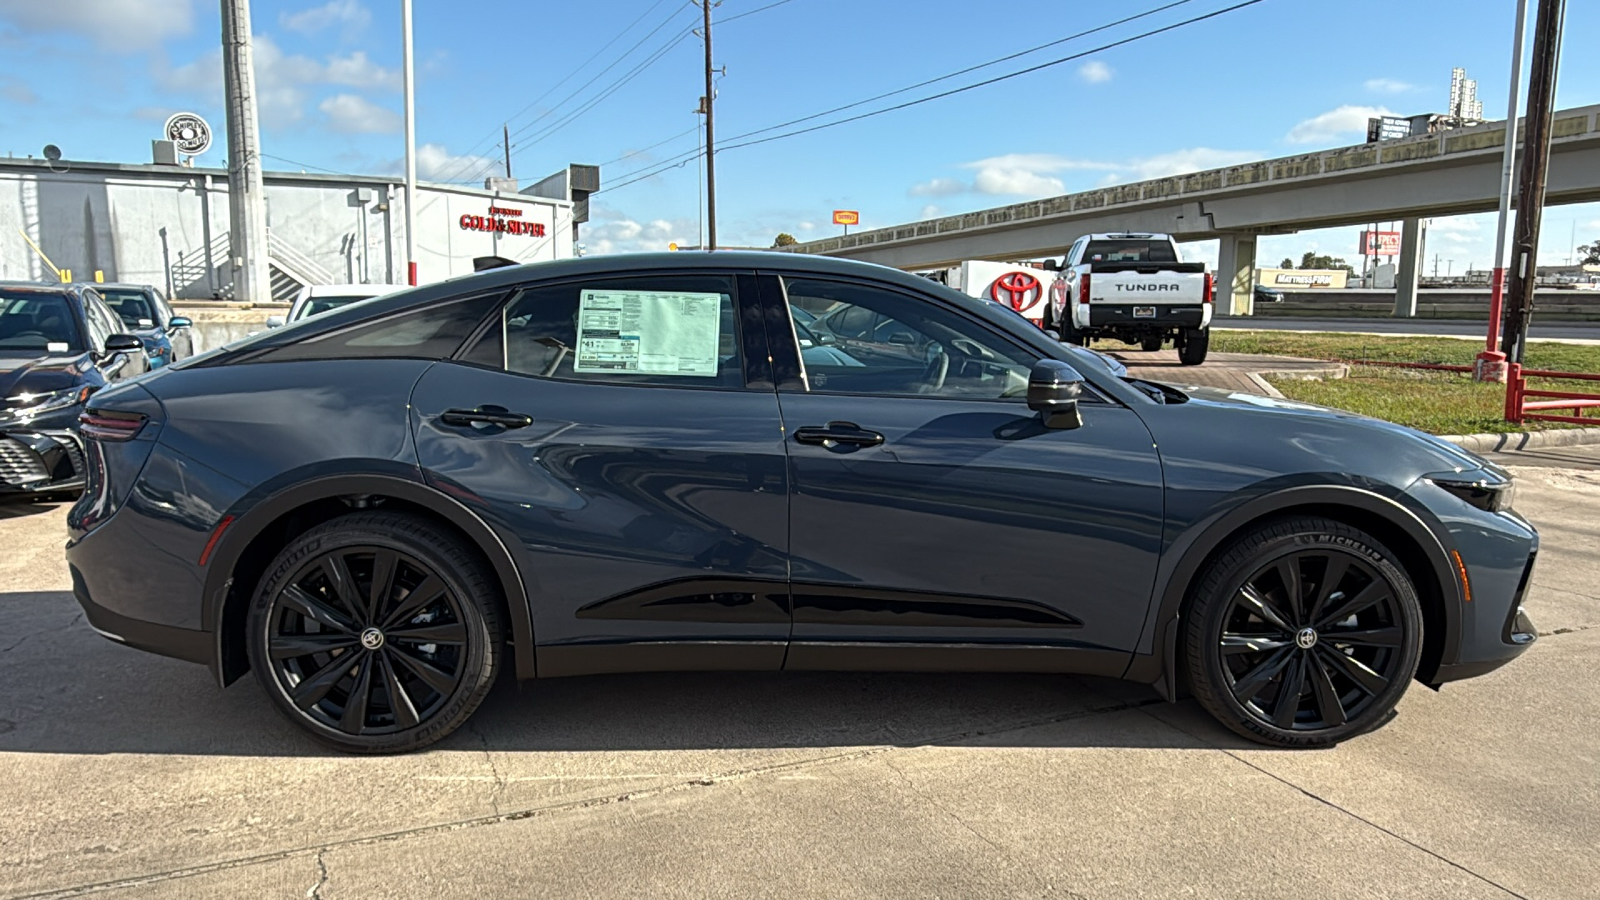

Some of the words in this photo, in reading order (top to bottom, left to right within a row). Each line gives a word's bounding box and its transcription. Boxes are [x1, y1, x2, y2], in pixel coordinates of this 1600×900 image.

[170, 121, 202, 132] SHIPLEY
[460, 213, 496, 232] GOLD
[506, 219, 546, 238] SILVER
[1115, 284, 1180, 292] TUNDRA
[1319, 534, 1382, 561] MICHELIN
